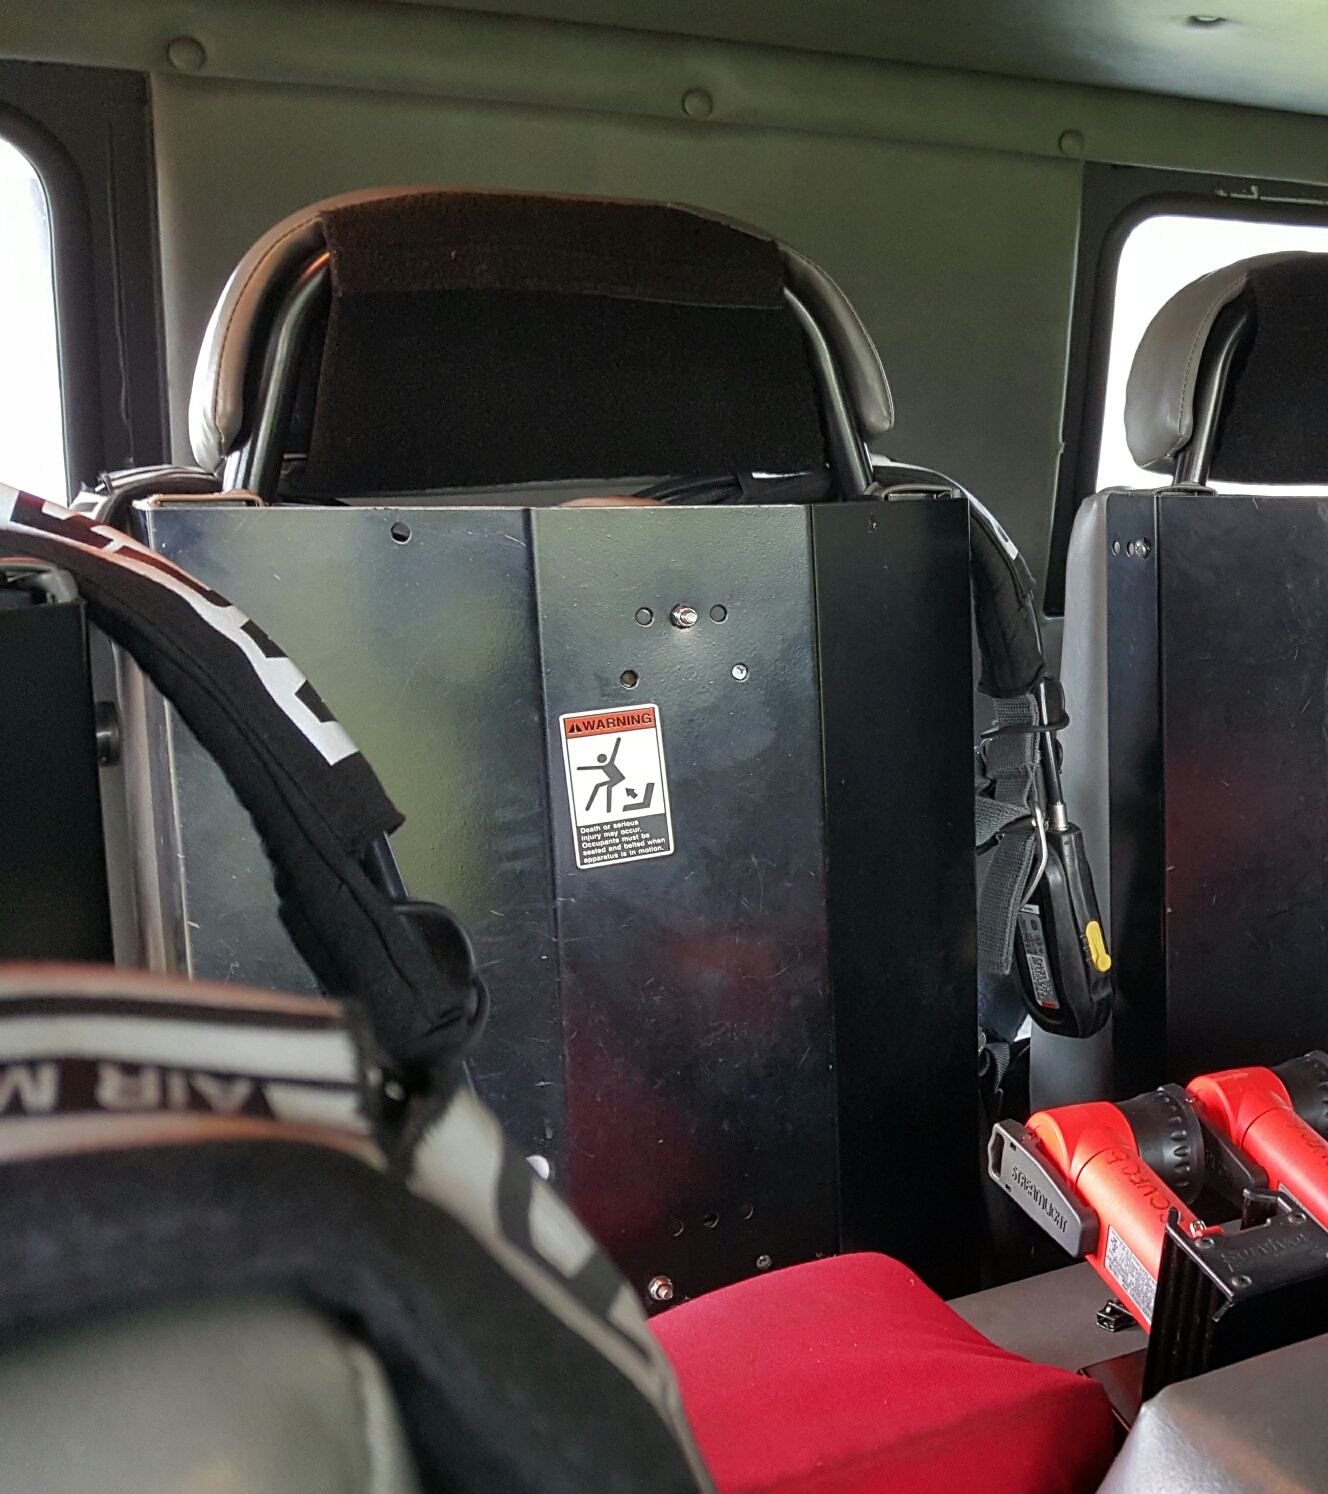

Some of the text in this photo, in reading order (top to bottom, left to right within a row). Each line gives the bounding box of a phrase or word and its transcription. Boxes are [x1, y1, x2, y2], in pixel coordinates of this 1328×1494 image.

[582, 713, 652, 731] WARNING
[580, 825, 601, 834] Death
[613, 820, 639, 829] serious
[581, 832, 601, 842] injury
[620, 827, 642, 835] occur.
[582, 838, 620, 849] Occupants
[622, 834, 639, 842] must
[582, 837, 666, 856] seated and belted when
[583, 853, 619, 864] apparatus
[638, 845, 664, 854] motion.
[97, 1060, 250, 1115] AIR
[1012, 1166, 1068, 1233] STREAMLIGHT
